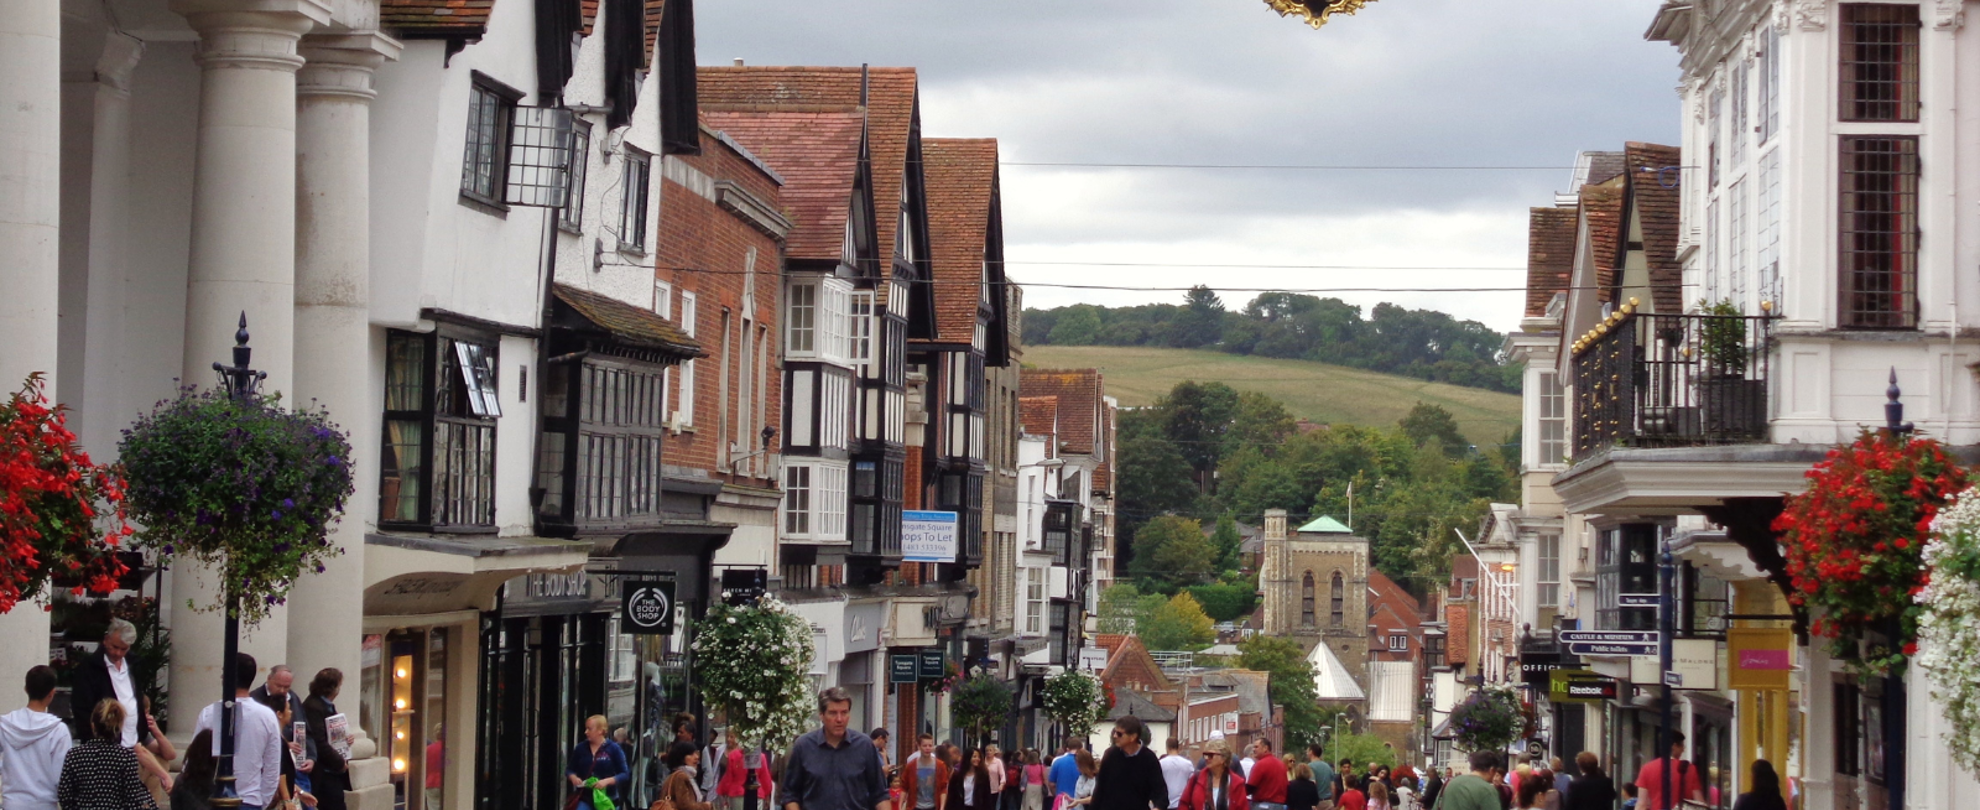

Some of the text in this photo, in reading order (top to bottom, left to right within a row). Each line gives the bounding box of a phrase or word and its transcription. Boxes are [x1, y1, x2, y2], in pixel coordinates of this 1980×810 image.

[927, 523, 952, 532] Square
[902, 532, 952, 542] ops To Let
[545, 573, 566, 596] BODY
[566, 571, 586, 596] SHOP
[636, 605, 660, 613] BODY
[637, 612, 659, 620] SHOP
[1569, 686, 1602, 694] Reebok
